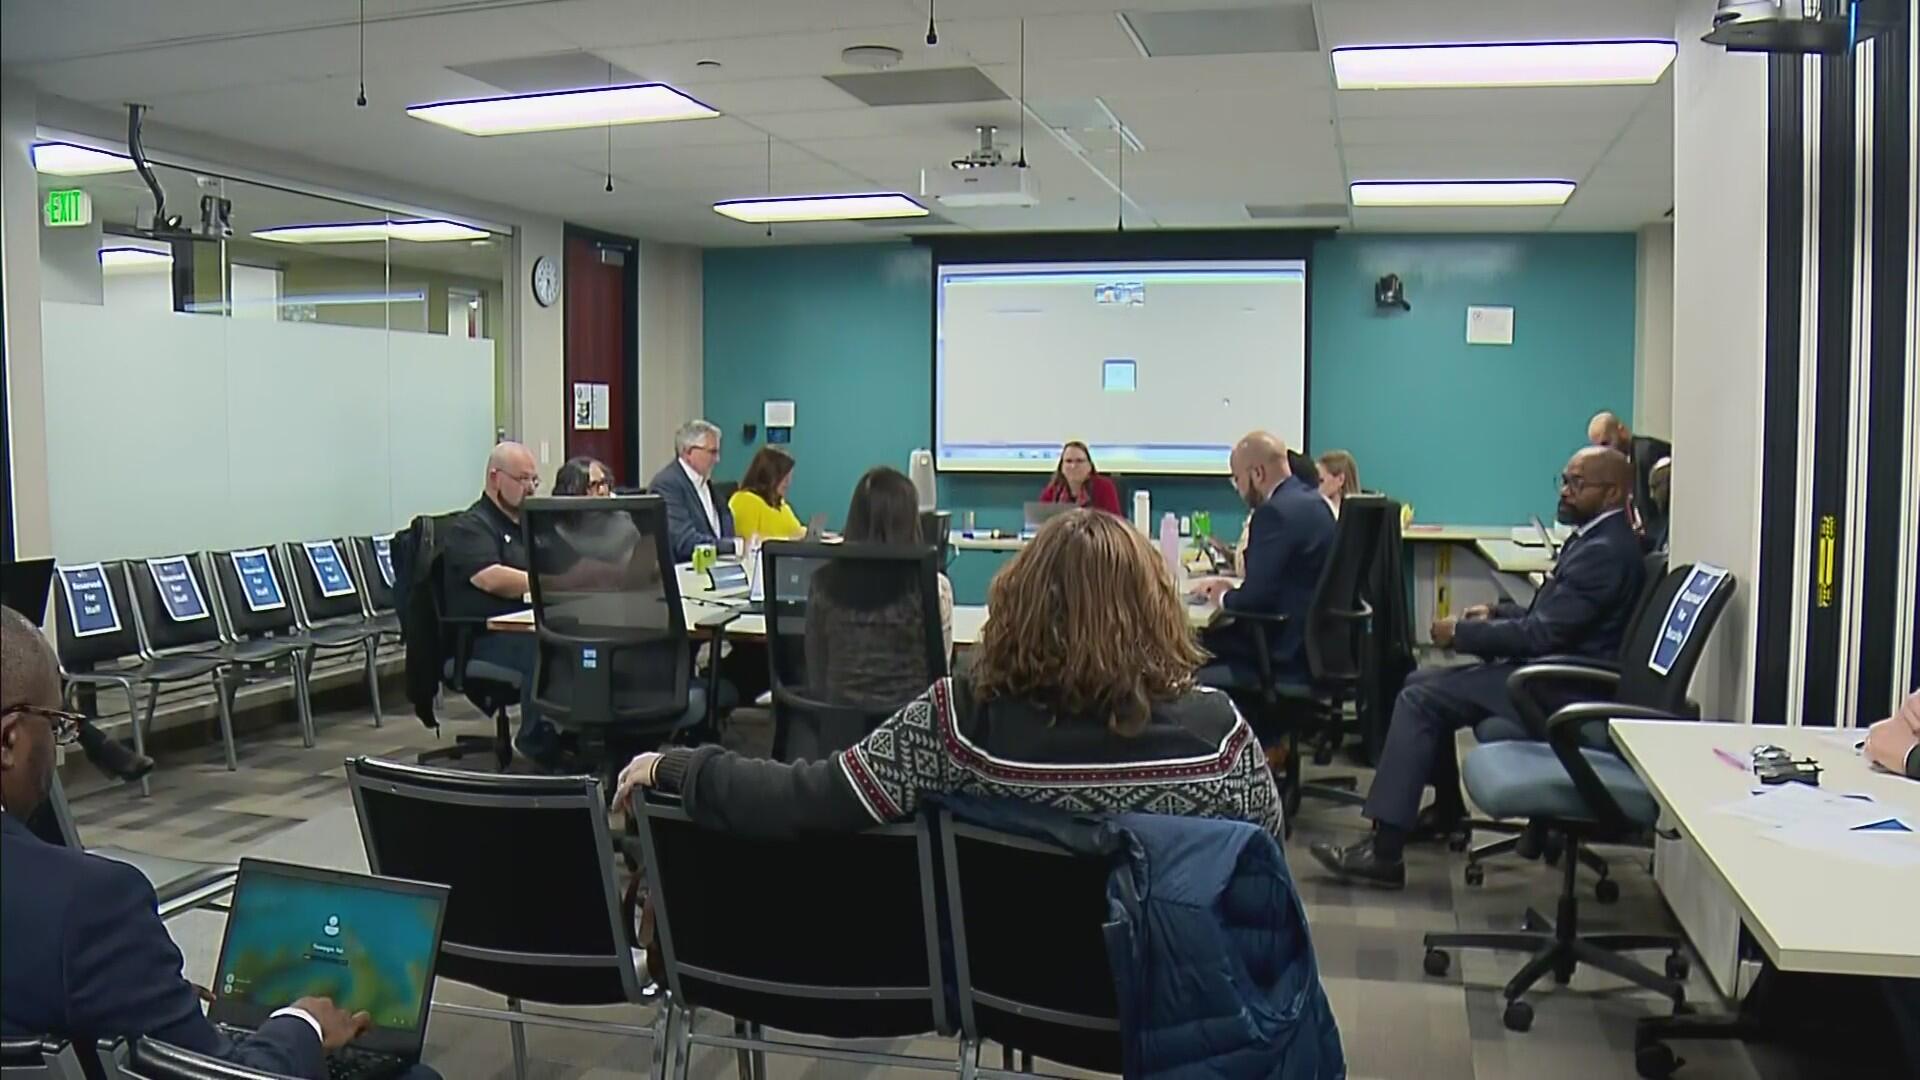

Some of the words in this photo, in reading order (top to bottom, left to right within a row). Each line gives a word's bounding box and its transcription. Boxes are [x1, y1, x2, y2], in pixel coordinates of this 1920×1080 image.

[51, 191, 80, 222] EXIT
[72, 580, 103, 590] Reserved
[84, 593, 96, 601] For
[84, 604, 101, 615] Staff
